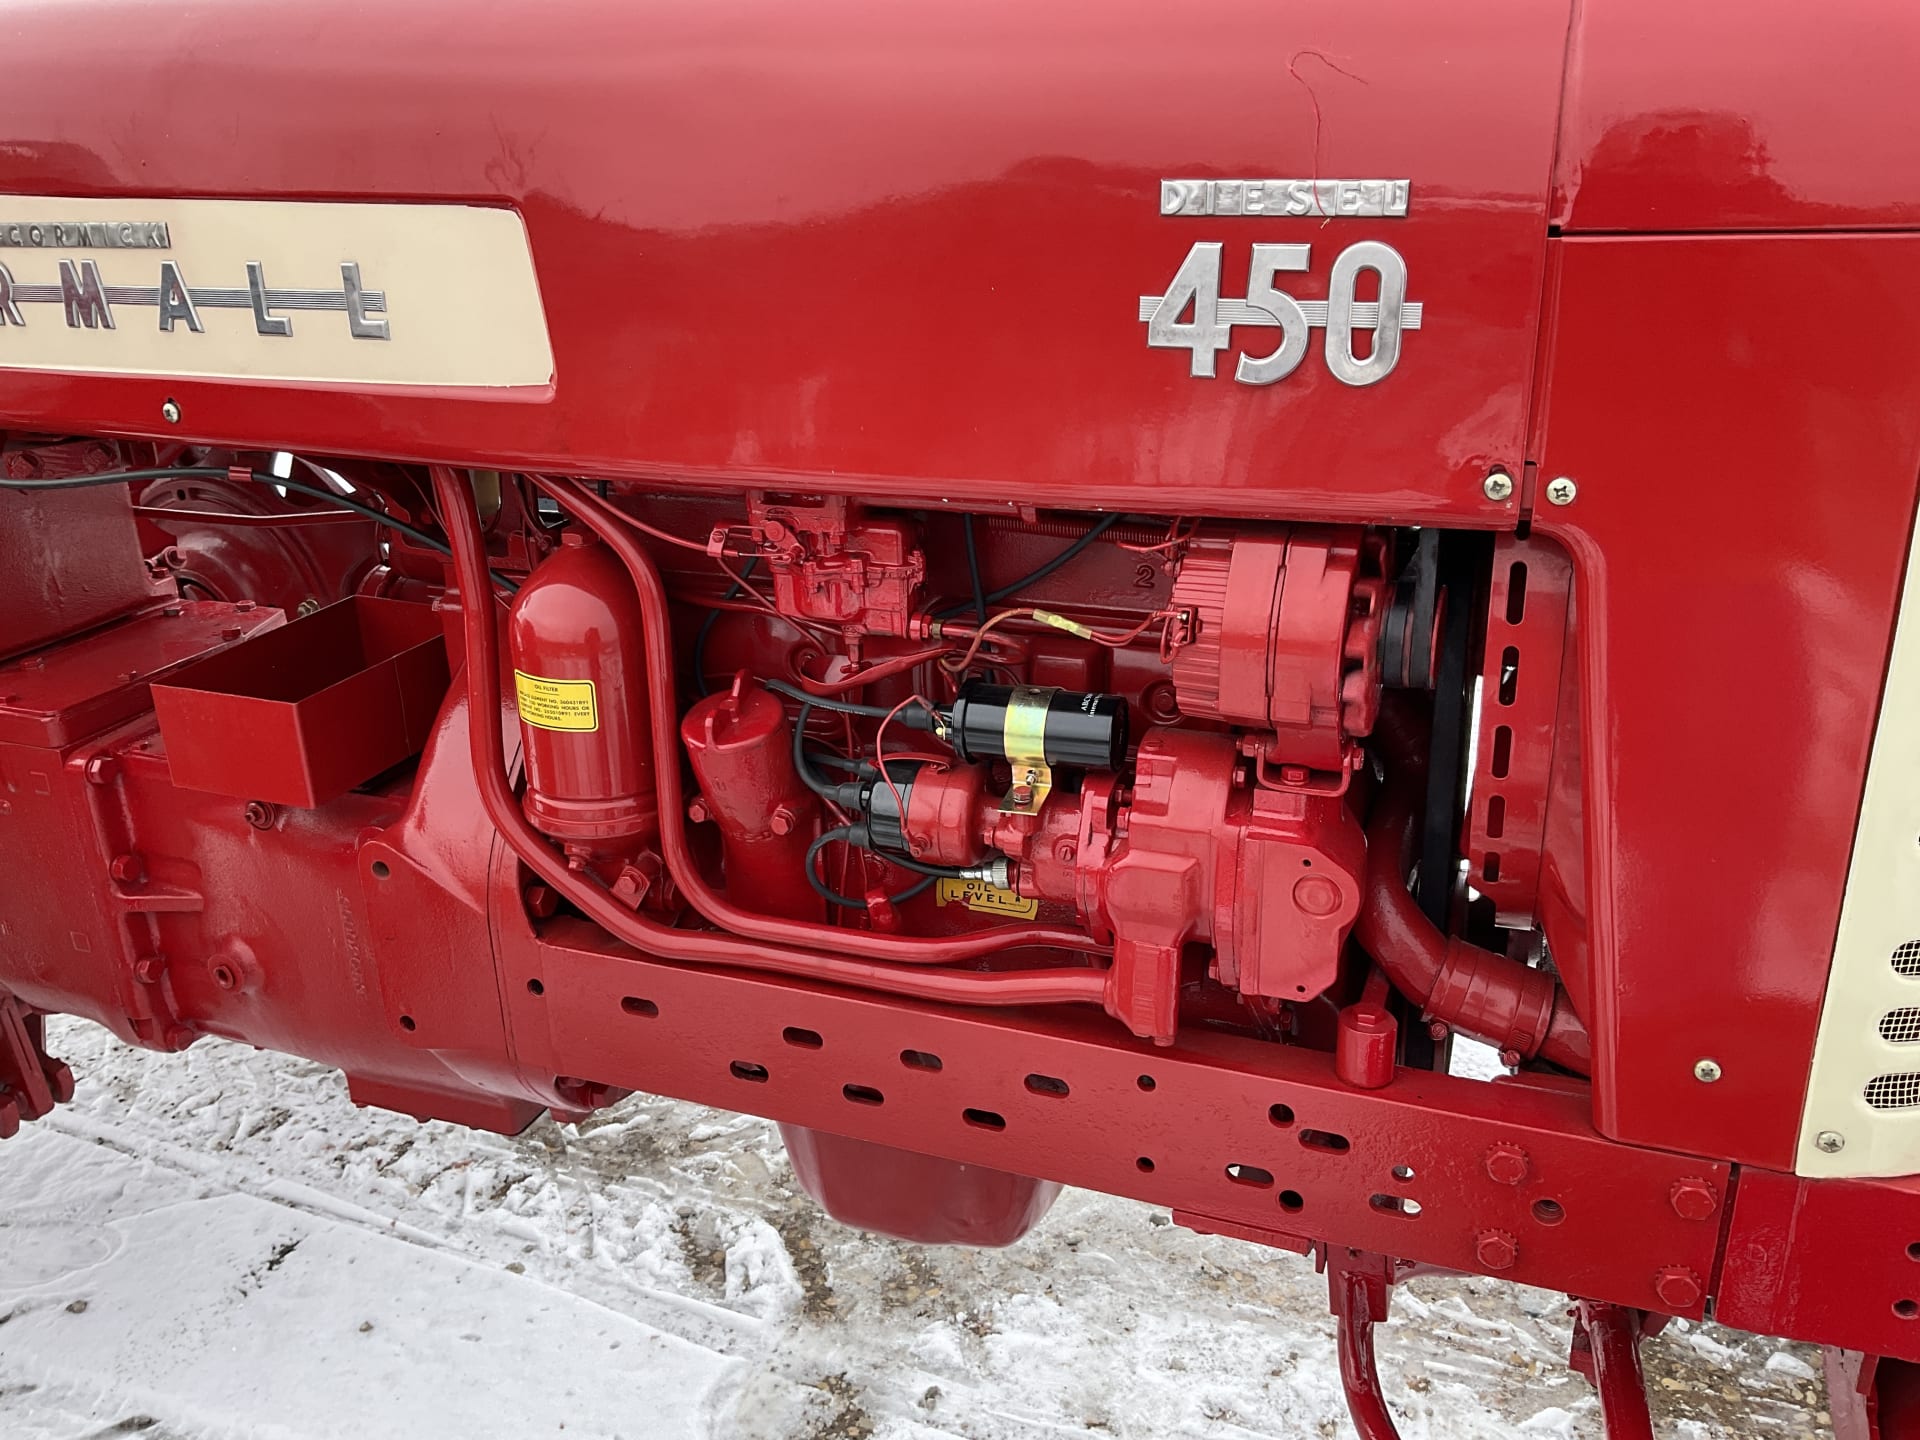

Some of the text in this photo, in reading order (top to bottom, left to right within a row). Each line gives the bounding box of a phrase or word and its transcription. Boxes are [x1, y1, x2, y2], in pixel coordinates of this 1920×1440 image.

[1160, 179, 1410, 217] DIESEL
[1147, 240, 1409, 387] 450
[1134, 565, 1155, 588] 2
[537, 702, 560, 710] WORKING
[950, 889, 1007, 905] LEVEL
[966, 882, 992, 893] OIL
